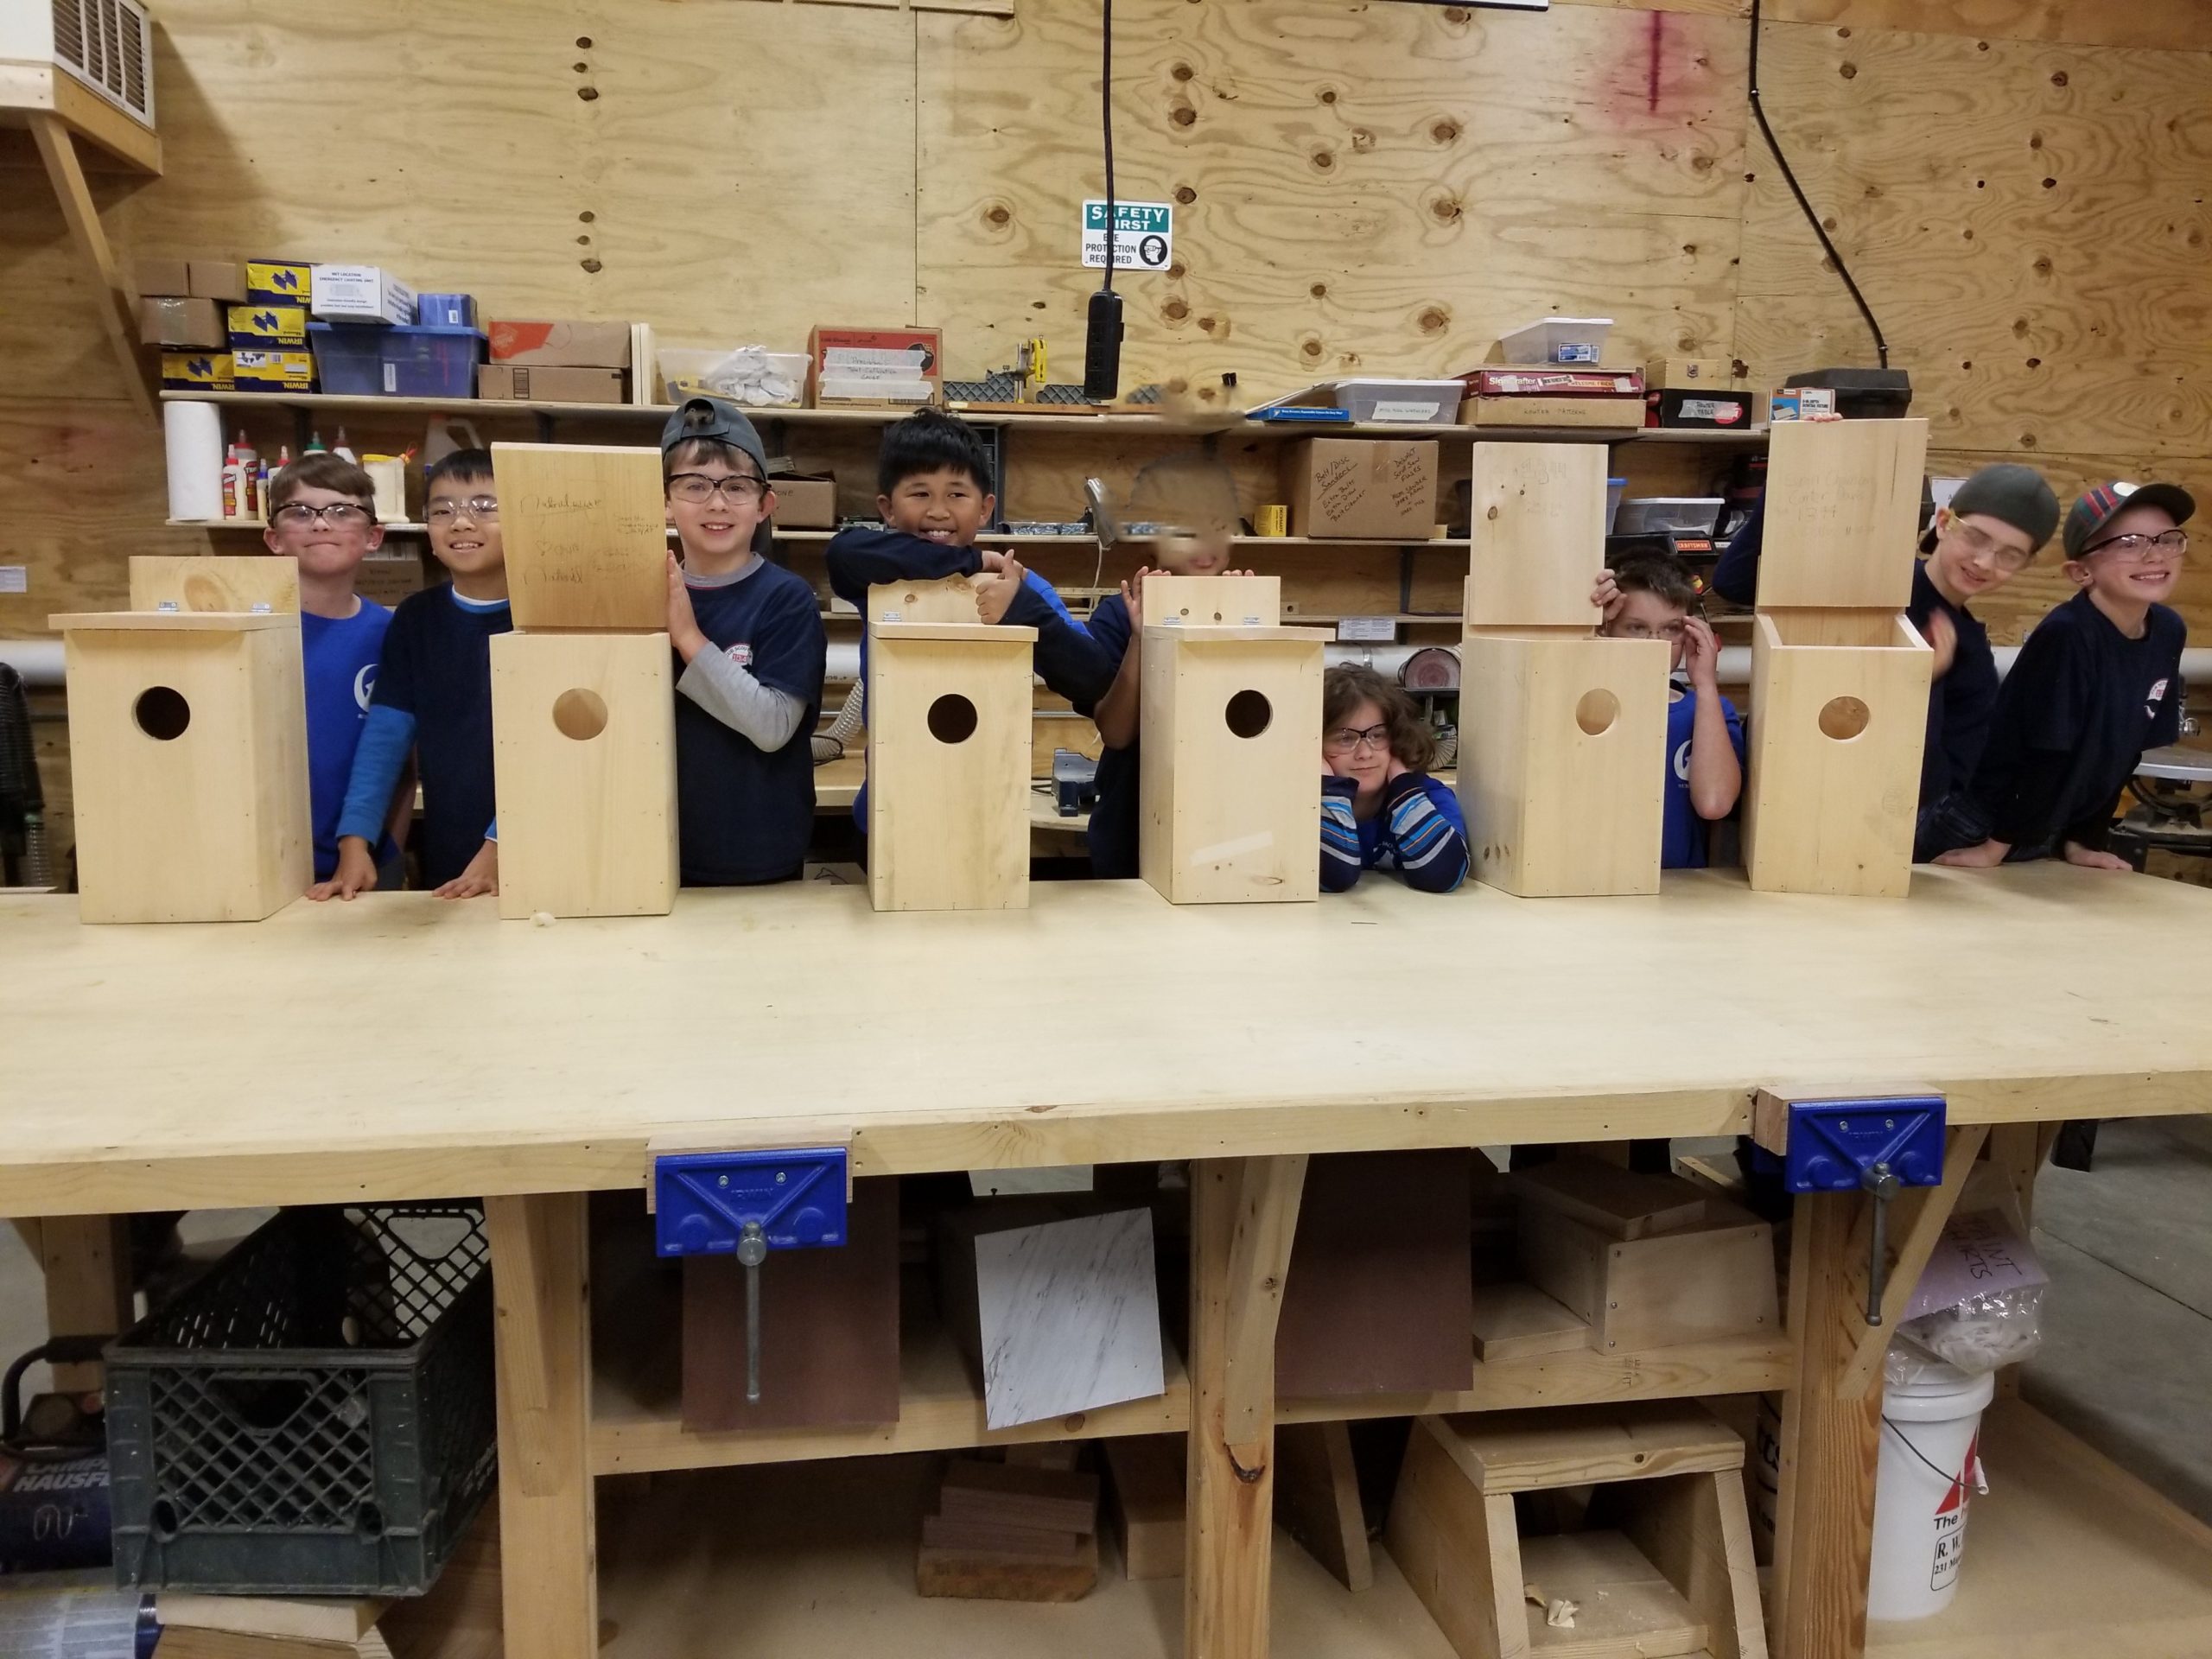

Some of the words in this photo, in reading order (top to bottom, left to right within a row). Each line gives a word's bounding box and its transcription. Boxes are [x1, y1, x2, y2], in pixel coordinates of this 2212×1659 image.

[1105, 219, 1150, 231] IRST
[1103, 233, 1120, 242] EE
[1085, 243, 1136, 254] PROTCTION
[1090, 254, 1132, 264] REQIRED
[277, 337, 303, 346] IRWIN
[1489, 377, 1536, 386] Sigrafter
[1934, 1515, 1958, 1530] The
[1936, 1542, 1948, 1559] R.
[1935, 1562, 1948, 1574] 231
